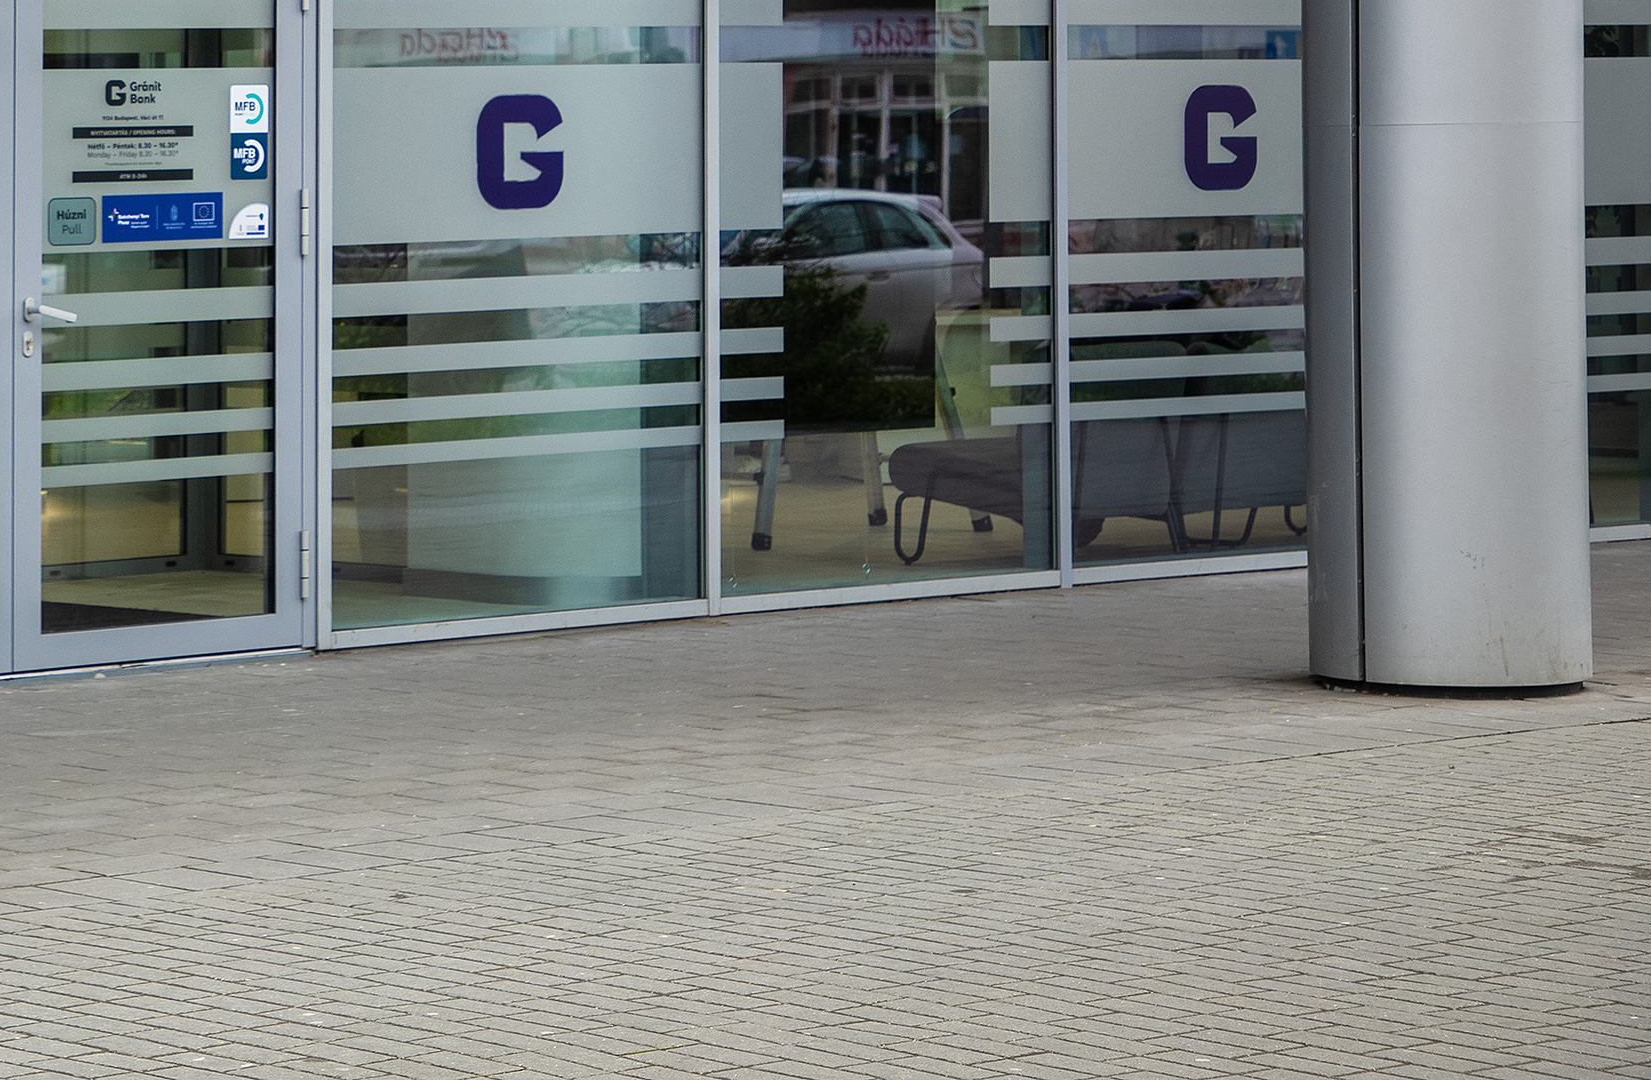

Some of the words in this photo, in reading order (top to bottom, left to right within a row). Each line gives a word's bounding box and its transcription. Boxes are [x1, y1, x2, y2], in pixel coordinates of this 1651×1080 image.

[129, 81, 162, 92] Gránit
[105, 80, 127, 106] G
[130, 93, 156, 104] Bank
[234, 101, 256, 111] MFB
[1184, 84, 1257, 191] G
[233, 148, 256, 159] MFB
[476, 94, 564, 210] G
[56, 208, 87, 220] Húzni
[61, 225, 83, 235] Pull
